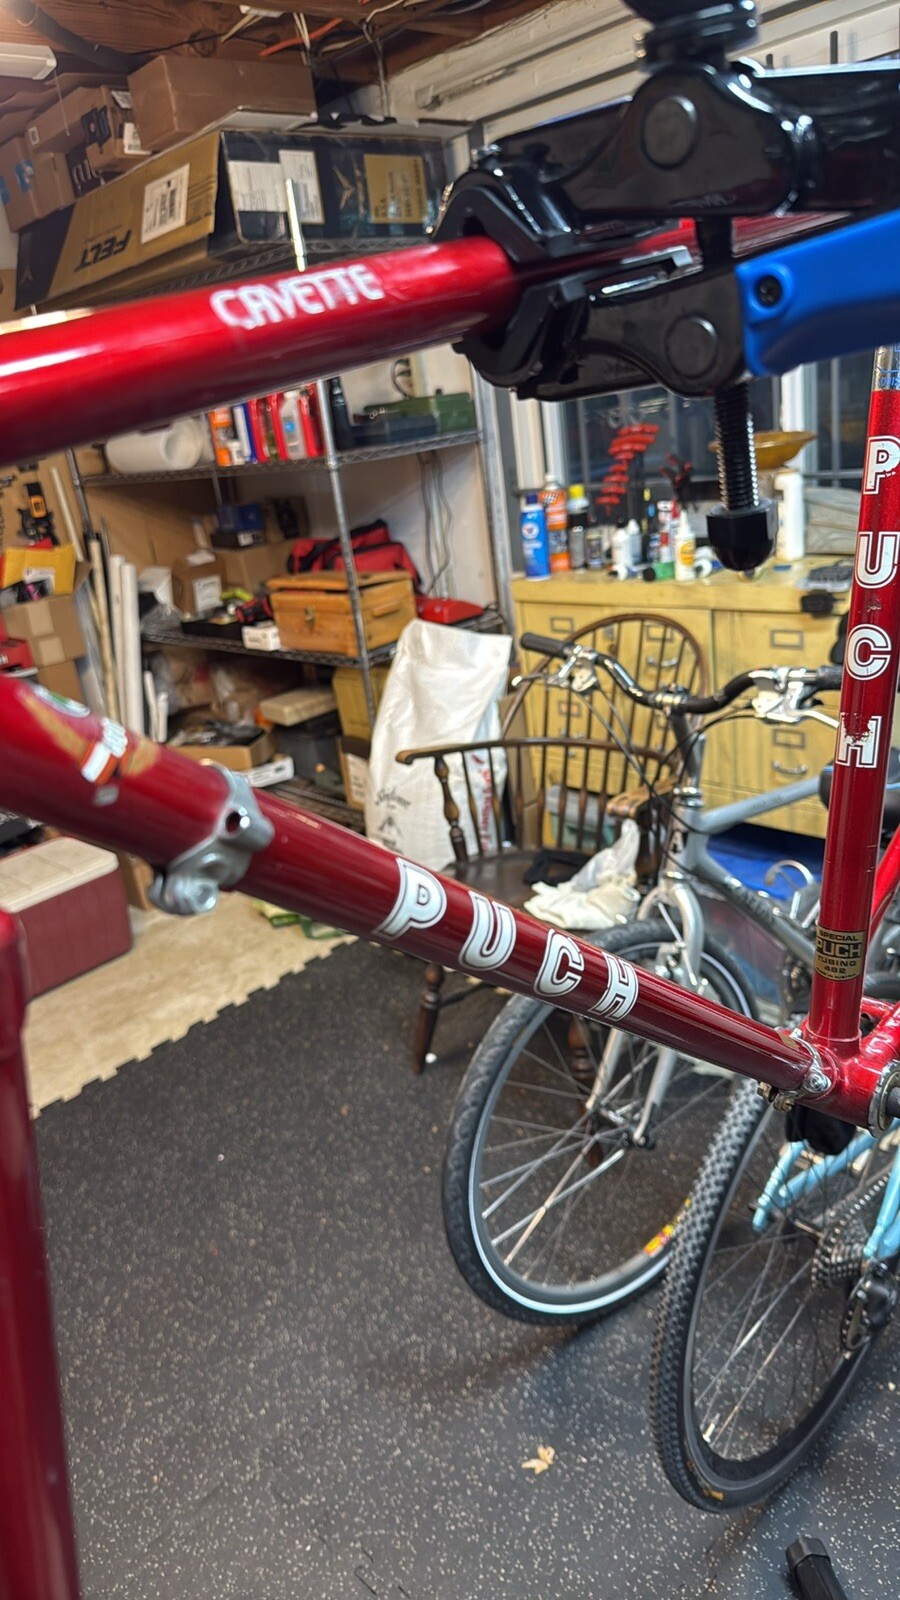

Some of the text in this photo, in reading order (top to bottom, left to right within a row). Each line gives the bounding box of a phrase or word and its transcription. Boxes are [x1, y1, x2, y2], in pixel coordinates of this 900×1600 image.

[74, 229, 132, 272] FELT
[209, 263, 386, 330] CAVETTE
[836, 435, 900, 769] PUCH
[371, 856, 640, 1022] PUCH
[816, 937, 862, 959] PUCH
[819, 930, 859, 942] SPECIAL
[817, 955, 857, 967] TUBING
[824, 965, 847, 974] 482
